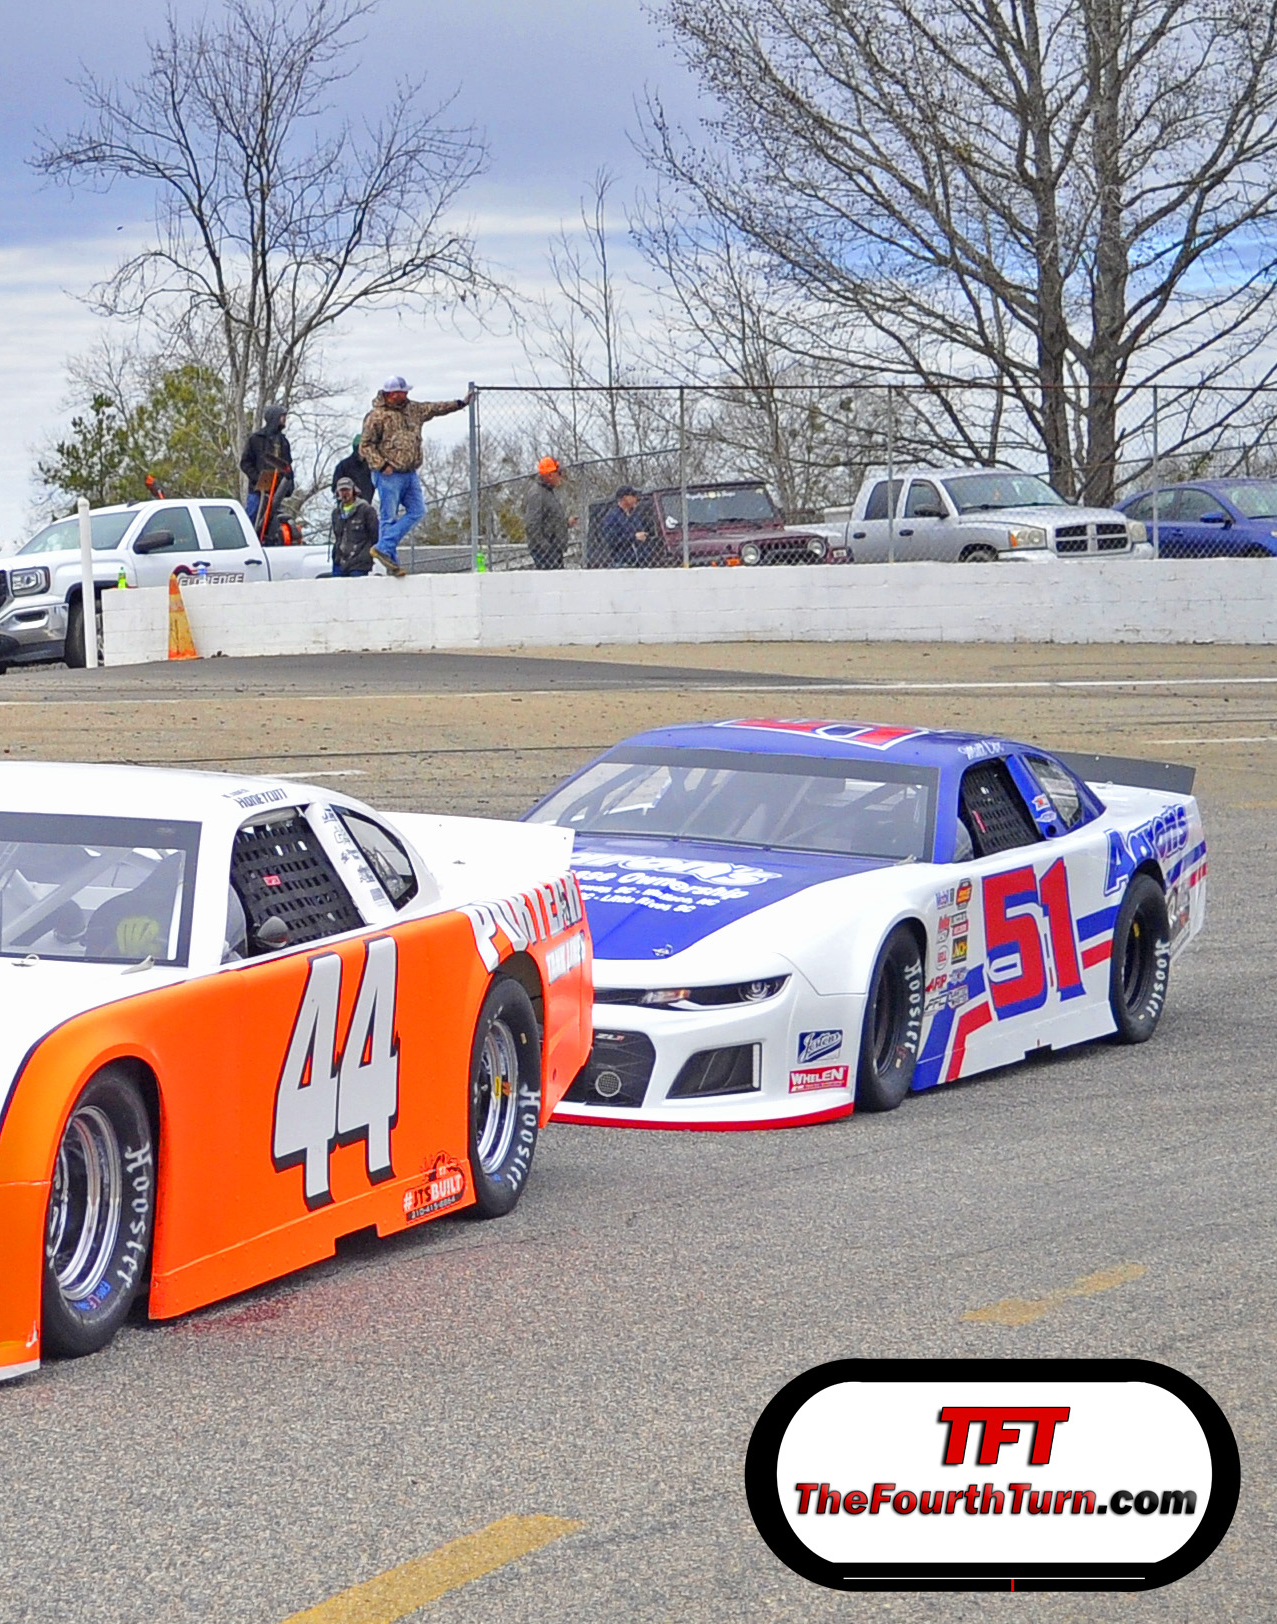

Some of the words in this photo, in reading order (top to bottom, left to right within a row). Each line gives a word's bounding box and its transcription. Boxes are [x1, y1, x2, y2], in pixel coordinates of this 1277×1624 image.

[617, 872, 750, 900] Ownership
[981, 856, 1087, 1021] 51
[903, 958, 923, 1054] Hoosier
[272, 935, 399, 1211] 44
[790, 1066, 844, 1086] WHELEN
[506, 1083, 542, 1191] Hoosier
[117, 1140, 153, 1289] Hoosier
